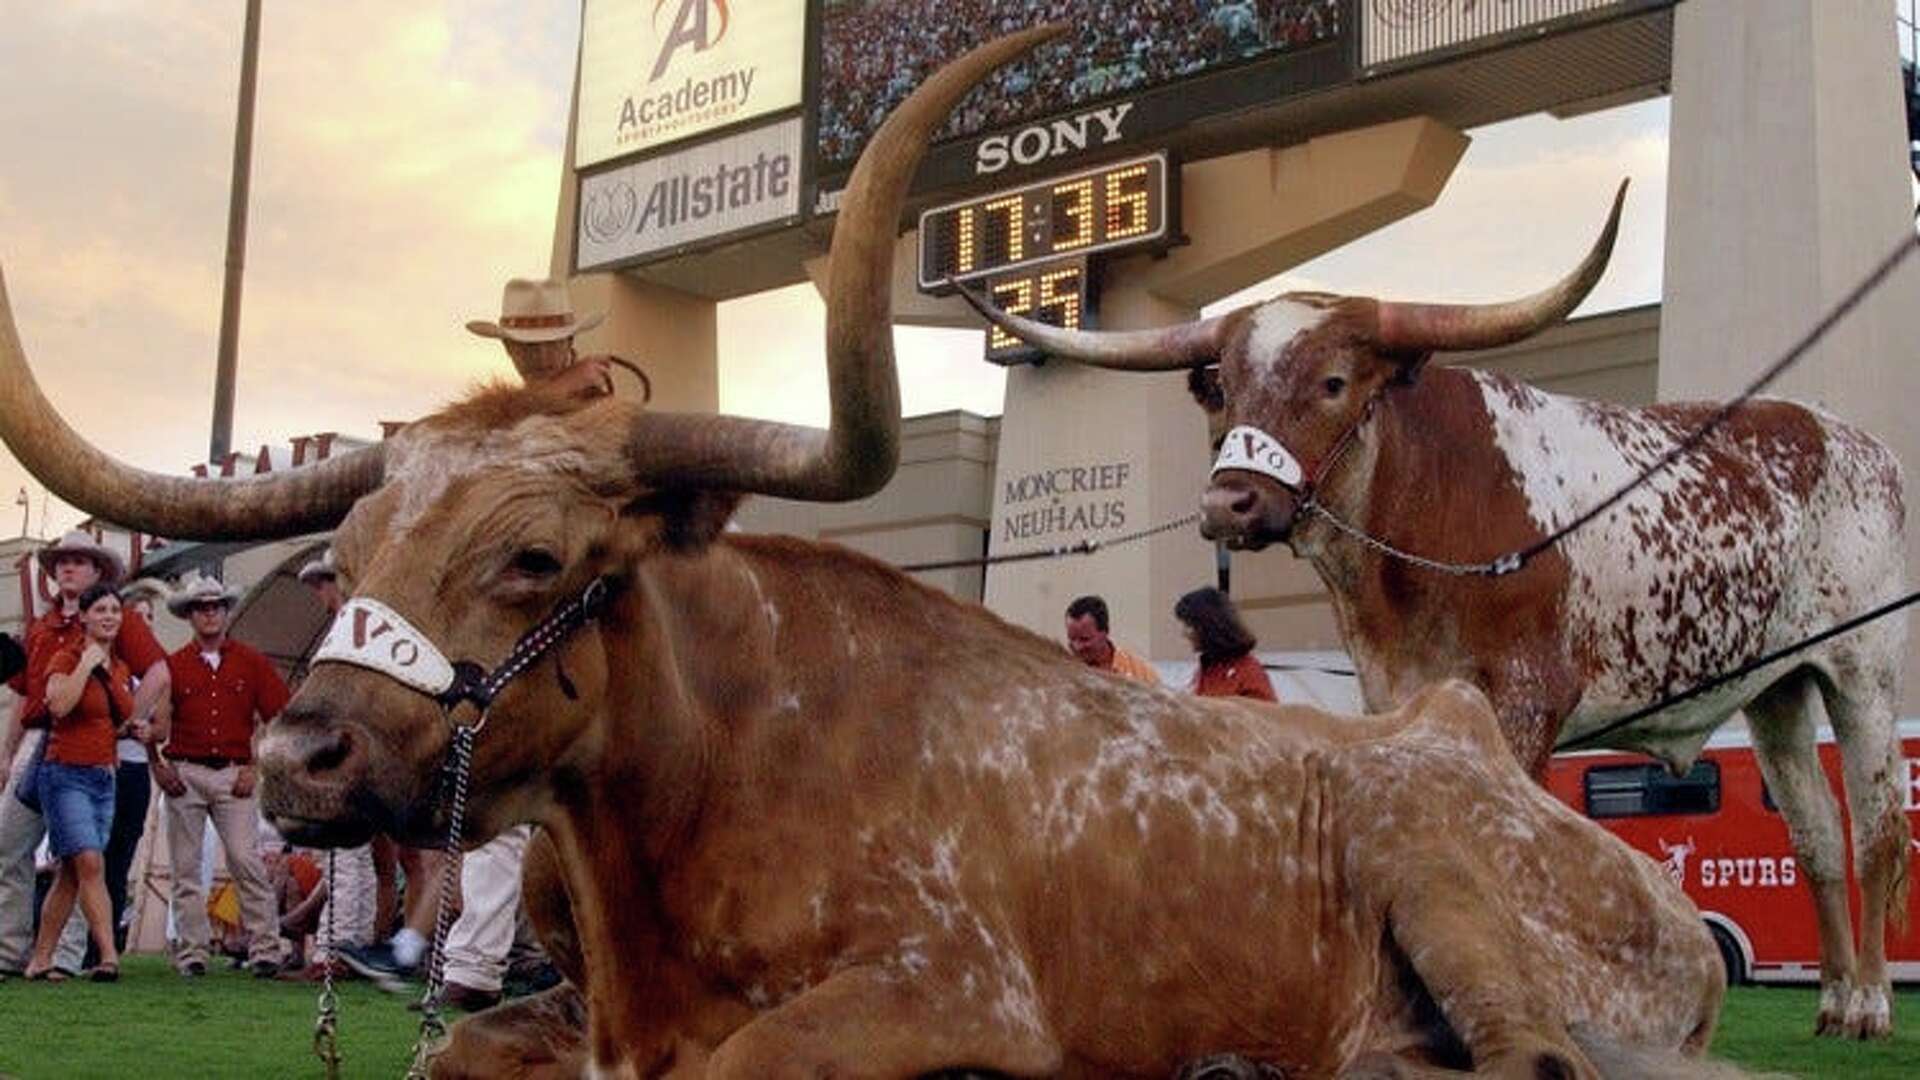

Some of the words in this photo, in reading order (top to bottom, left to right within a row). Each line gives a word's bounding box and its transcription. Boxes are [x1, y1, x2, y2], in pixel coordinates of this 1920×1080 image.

[618, 67, 754, 132] Academy
[976, 103, 1133, 174] SONY
[636, 152, 791, 235] Allstate
[992, 268, 1079, 349] 25
[1226, 433, 1285, 470] VO
[1005, 463, 1130, 505] MONCRIEF
[1003, 501, 1126, 543] NEUHAUS
[341, 607, 419, 666] VO
[1700, 857, 1797, 888] SPURS
